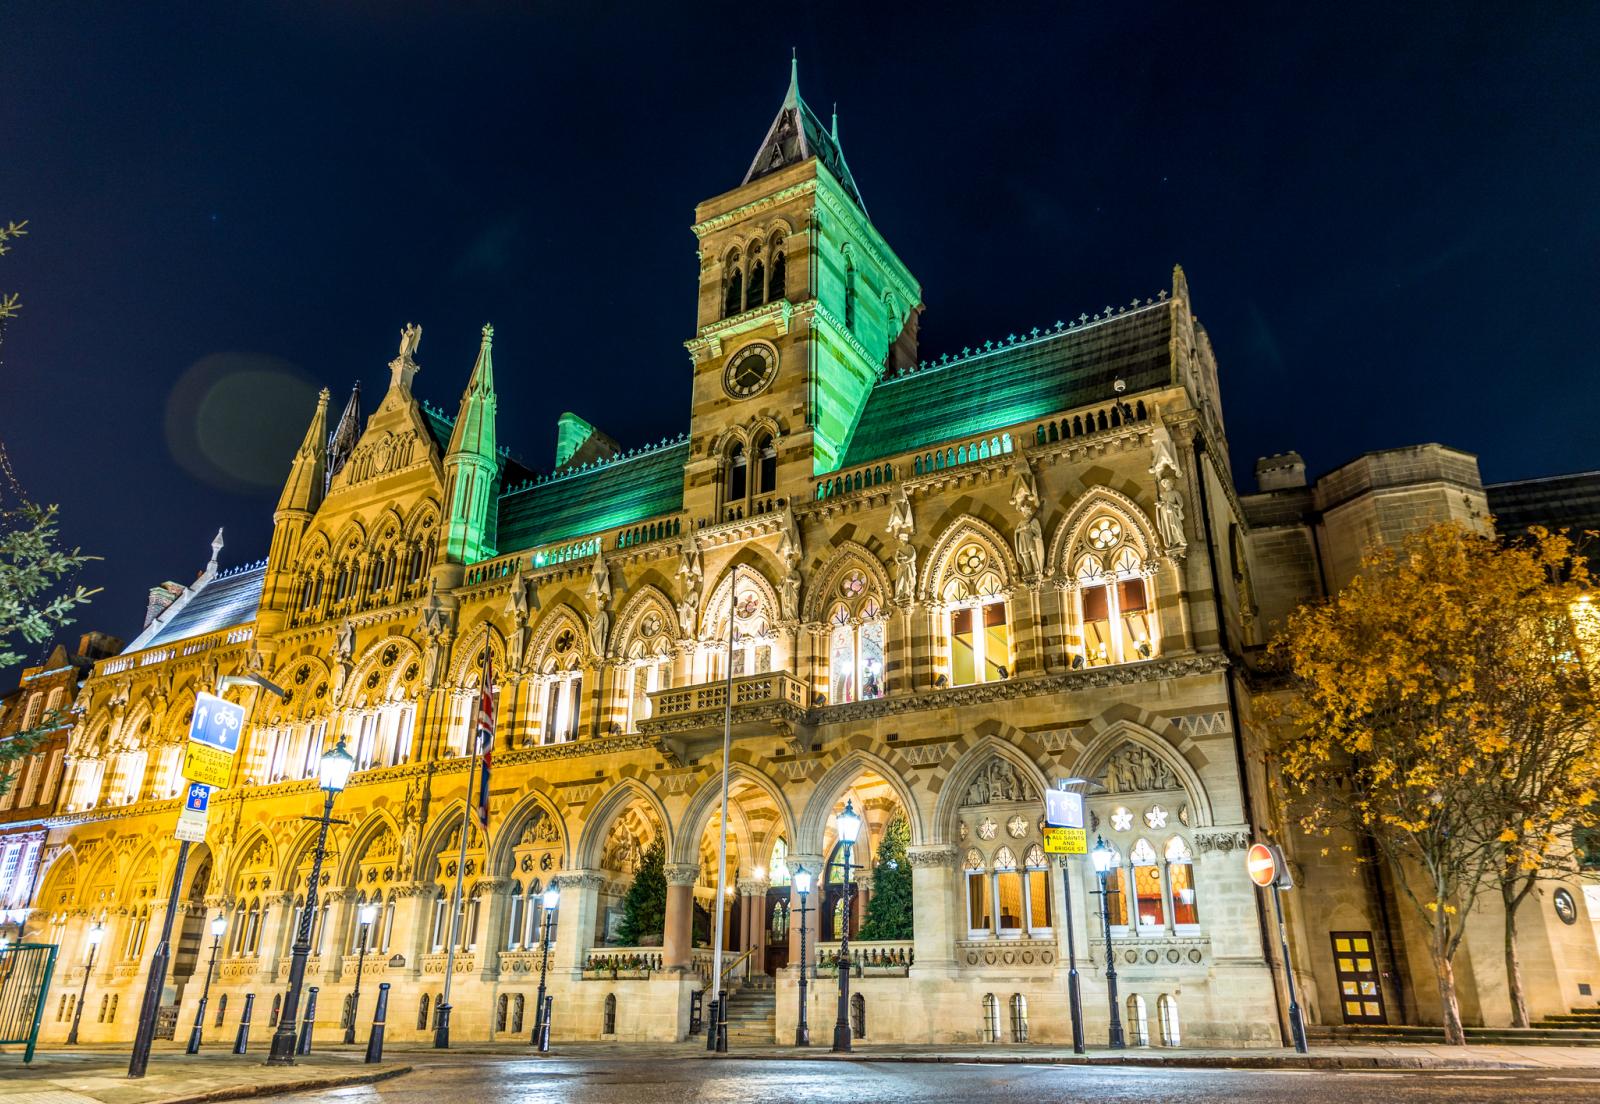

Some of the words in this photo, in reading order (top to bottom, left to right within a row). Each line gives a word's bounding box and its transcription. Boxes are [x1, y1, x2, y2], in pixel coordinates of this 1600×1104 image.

[198, 748, 222, 760] ACCESS
[195, 755, 206, 763] ALL
[208, 758, 230, 770] SAINTS
[194, 770, 217, 782] BRIDGE
[205, 766, 217, 774] AND
